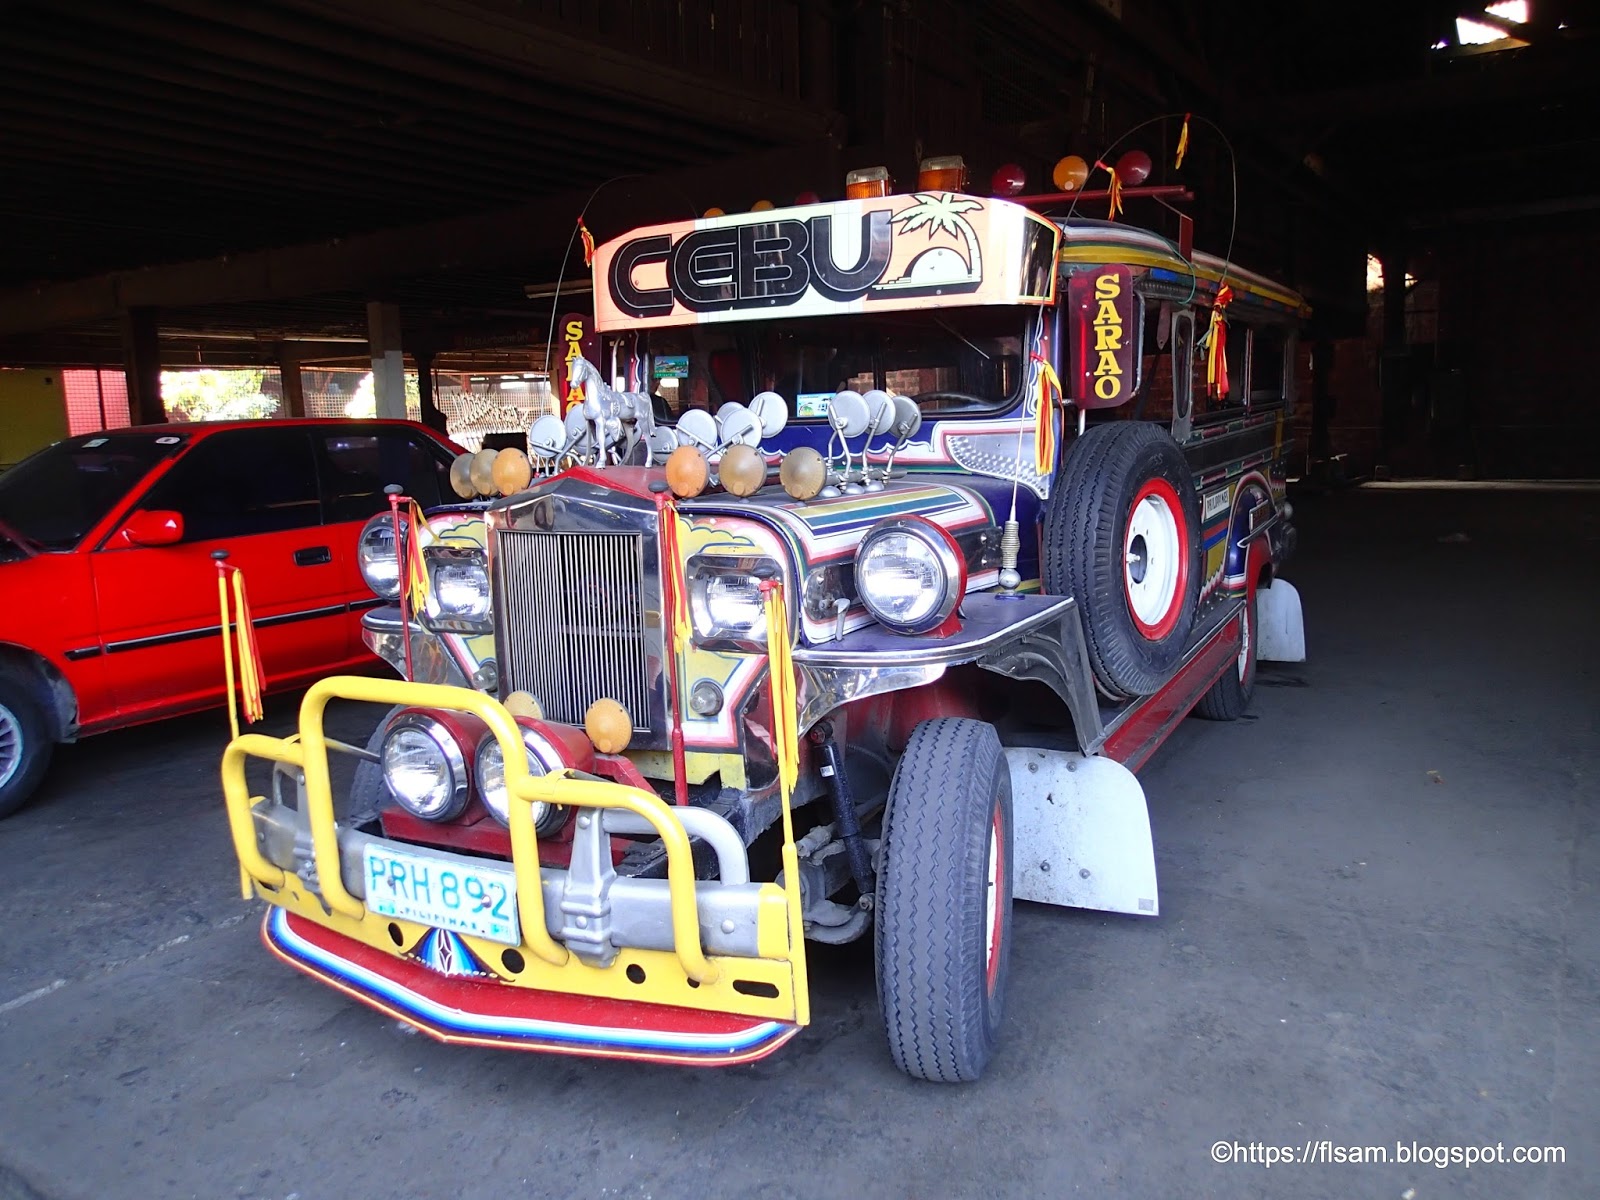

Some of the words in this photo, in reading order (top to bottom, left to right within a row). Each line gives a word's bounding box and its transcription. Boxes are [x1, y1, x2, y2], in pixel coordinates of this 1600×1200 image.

[608, 208, 893, 318] CEBU
[1093, 273, 1123, 400] SARAO
[369, 856, 432, 904] PRH
[440, 871, 510, 921] 892
